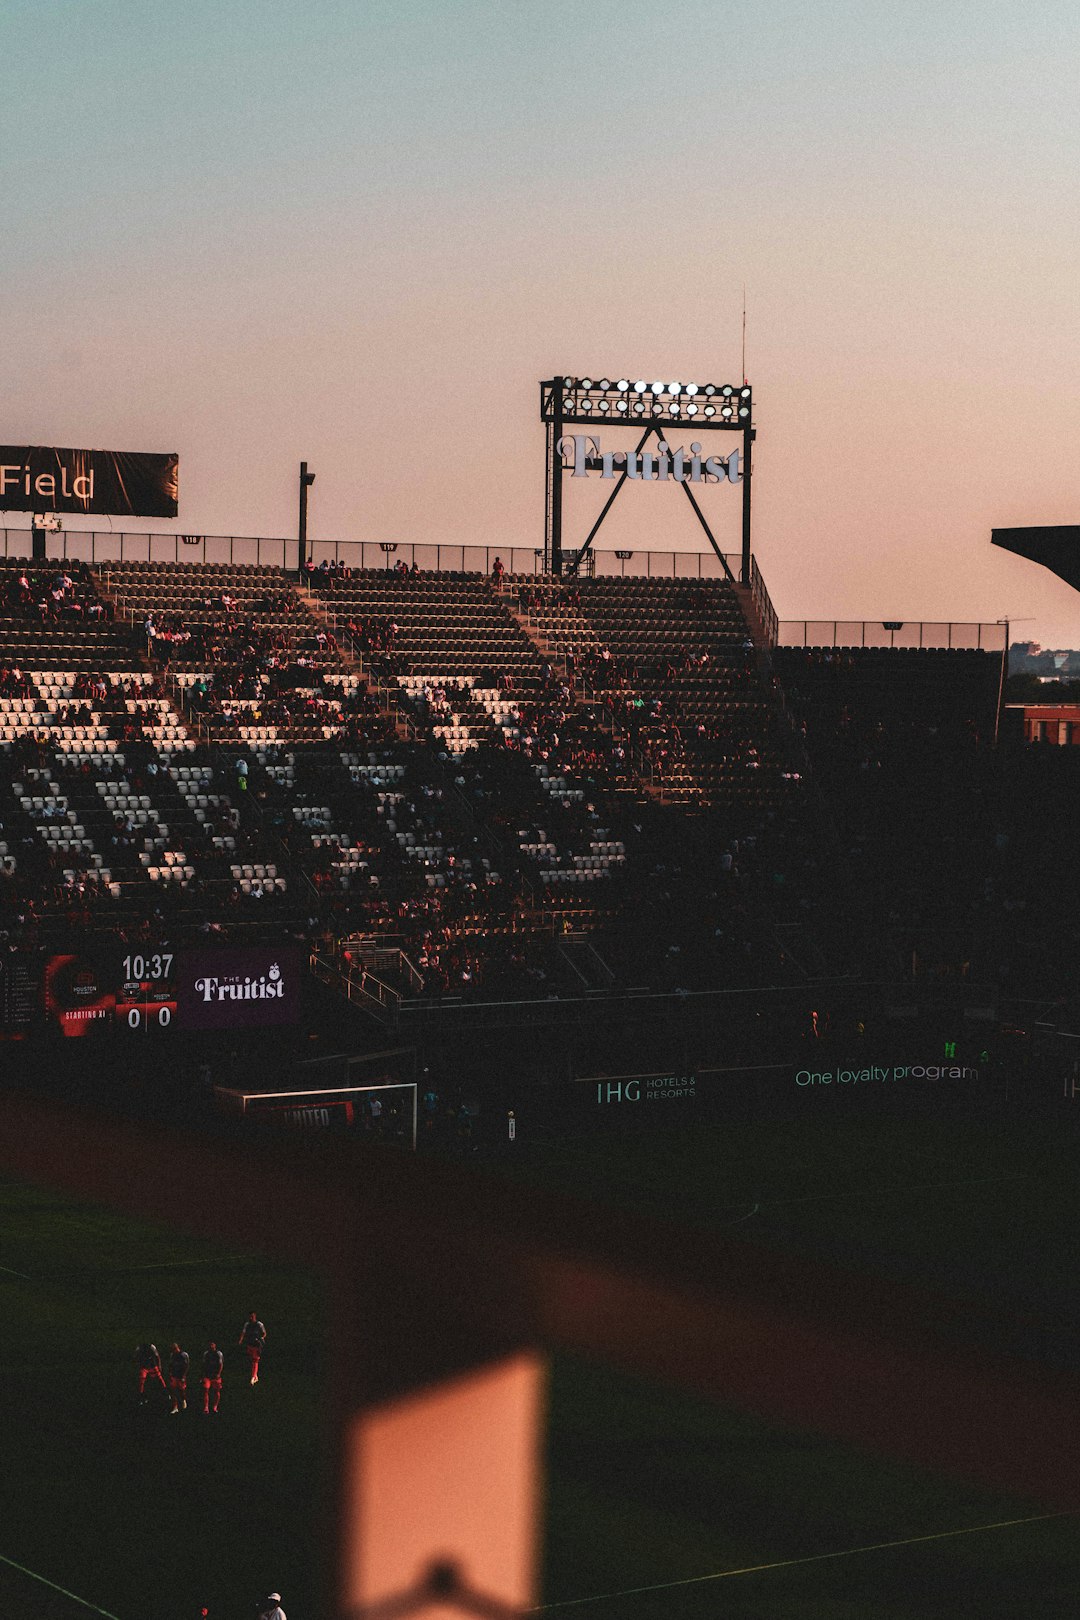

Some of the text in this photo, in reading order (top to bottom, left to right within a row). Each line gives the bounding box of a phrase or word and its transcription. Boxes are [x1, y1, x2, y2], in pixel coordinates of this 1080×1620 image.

[556, 434, 744, 484] Fruitist
[0, 465, 95, 499] Field
[185, 536, 197, 544] 118
[122, 954, 174, 980] 10:37
[194, 976, 285, 1002] Fruitist
[128, 1008, 141, 1028] 0
[158, 1006, 171, 1027] 0
[795, 1065, 979, 1087] One loyalty program
[597, 1076, 696, 1104] IHG HOTELS &
[646, 1088, 696, 1099] RESORTS
